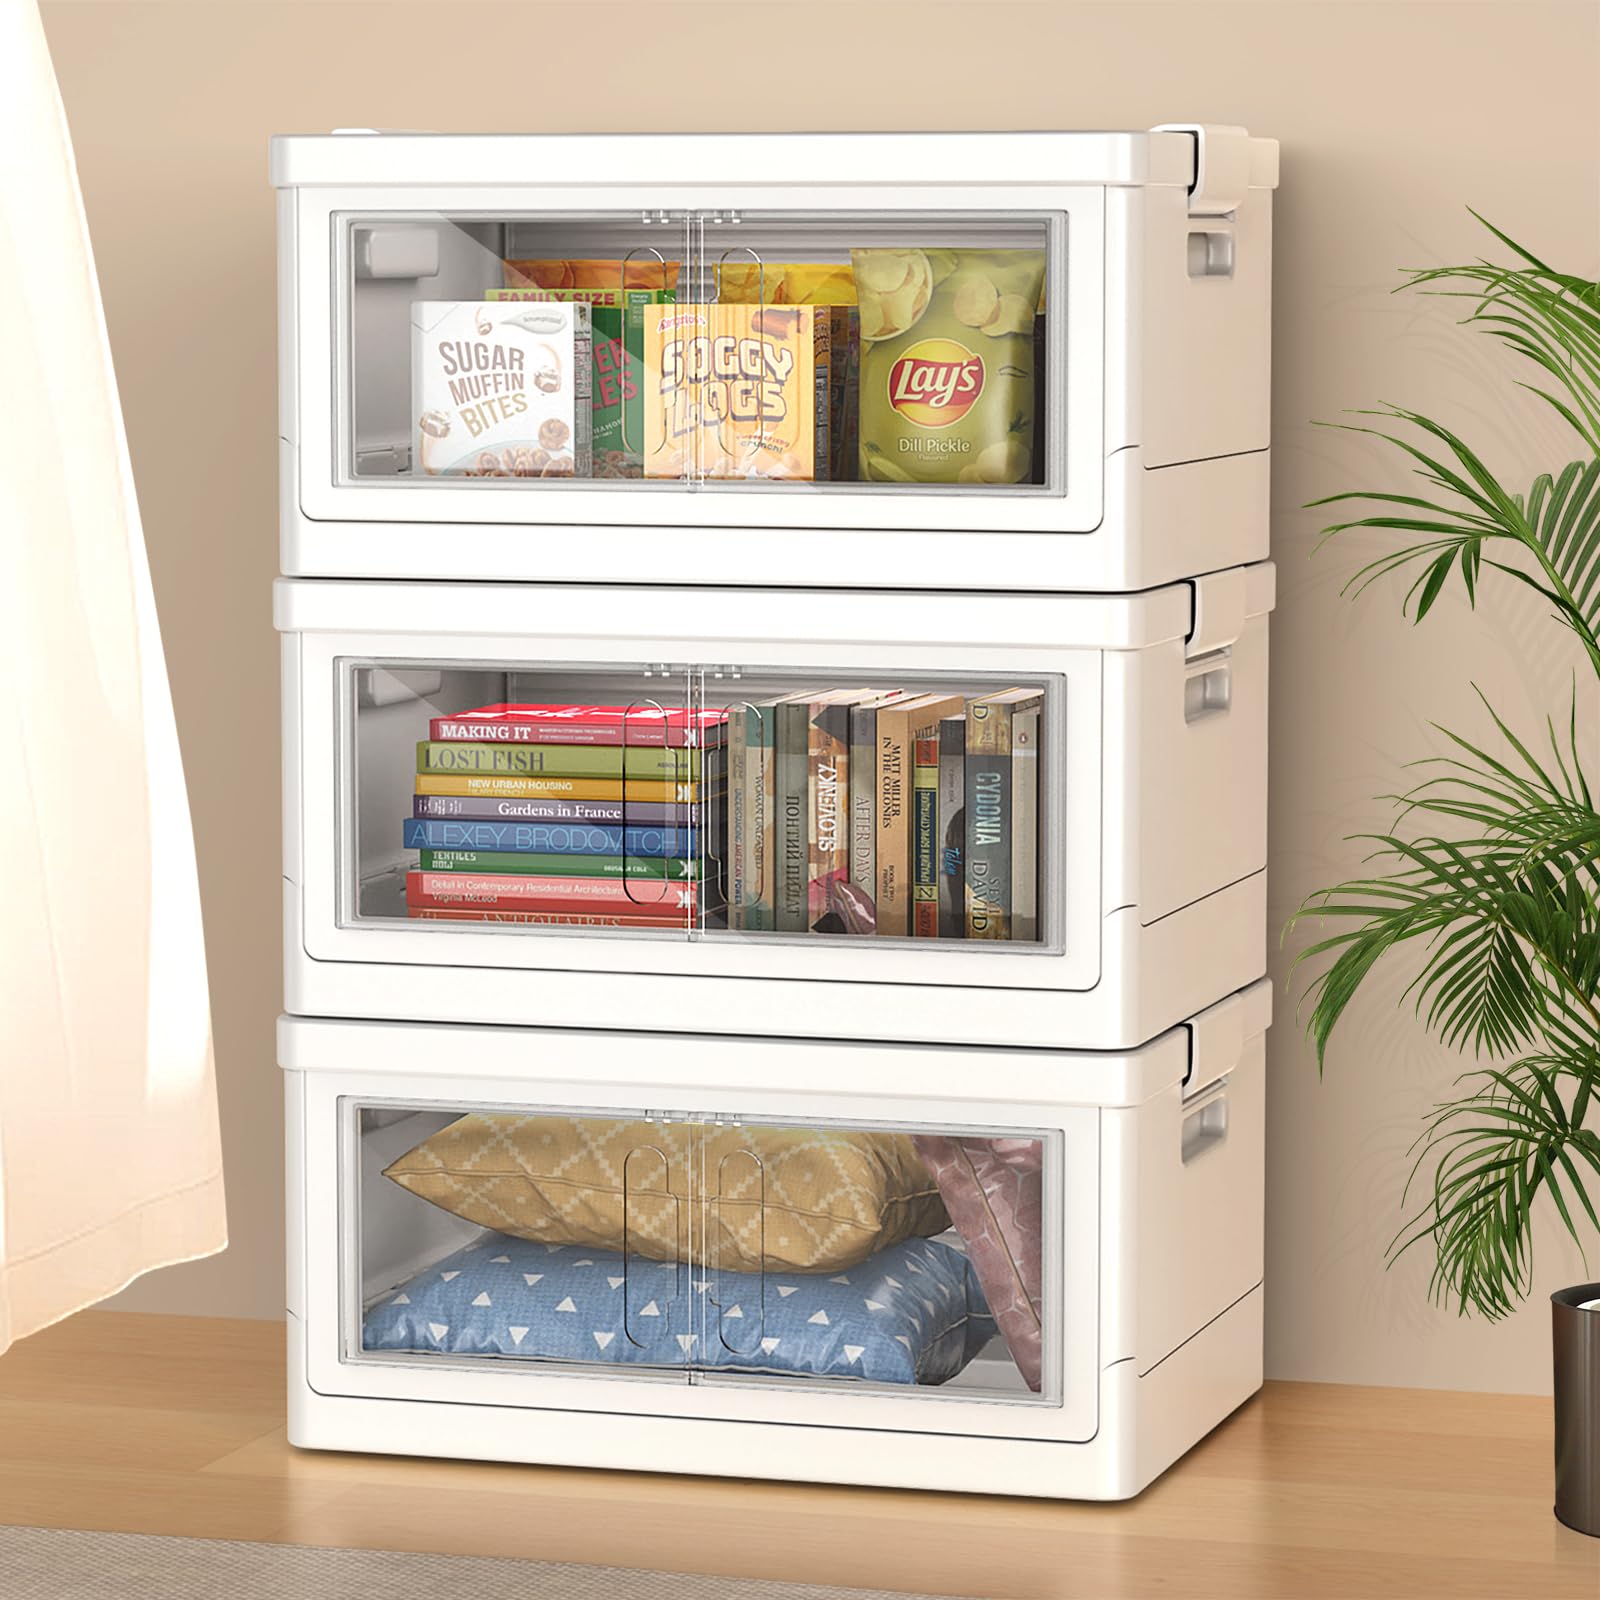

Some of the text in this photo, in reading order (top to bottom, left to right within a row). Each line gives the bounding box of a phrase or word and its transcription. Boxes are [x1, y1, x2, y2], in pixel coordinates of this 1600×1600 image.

[571, 292, 616, 306] SIZE
[438, 341, 524, 376] SUGAR
[660, 336, 793, 395] SOGGY
[448, 372, 524, 406] MUFFIN
[894, 359, 979, 408] Lay's
[459, 393, 528, 438] BITES
[899, 438, 970, 452] Dill Pickle
[441, 724, 509, 740] MAKING
[513, 727, 531, 740] IT
[425, 748, 544, 771] LOST FISH
[468, 779, 573, 791] NEW URBAN HOUSING
[755, 776, 764, 816] WOMAN
[882, 737, 891, 829] IN THE COLONIES
[891, 744, 901, 818] MATT MILLER
[498, 802, 621, 819] Gardens in France
[734, 788, 742, 842] UNDERSTANDING
[817, 763, 838, 853] SLOVENKY
[975, 772, 1001, 846] CYDONIA
[411, 823, 677, 854] ALEXEY BRODOVTCH
[432, 851, 476, 861] TEXTILES
[855, 796, 872, 883] AFTER DAYS
[734, 844, 742, 878] AMERICAN
[785, 796, 803, 917] ПОНТИЙ ПИЛАТ
[432, 880, 454, 889] Detail
[457, 880, 464, 889] in
[466, 881, 524, 892] Contemporary
[527, 884, 571, 893] Residential
[432, 892, 498, 903] Virginia McLeod
[734, 879, 742, 905] POWER
[971, 861, 989, 932] DAVID
[988, 877, 1001, 915] SEYI
